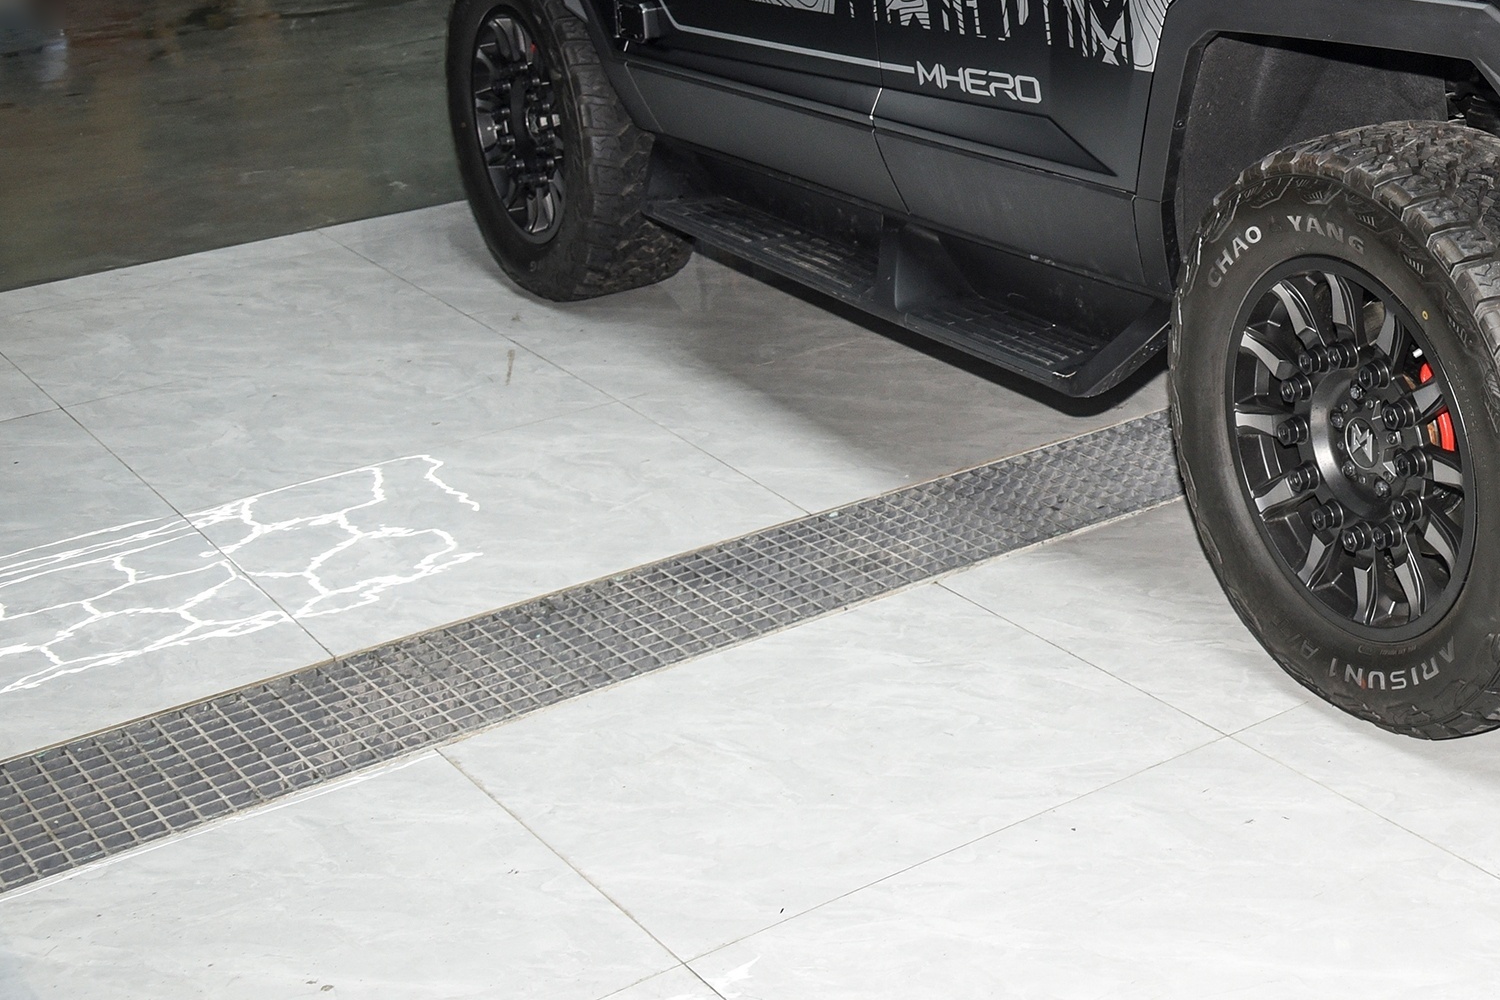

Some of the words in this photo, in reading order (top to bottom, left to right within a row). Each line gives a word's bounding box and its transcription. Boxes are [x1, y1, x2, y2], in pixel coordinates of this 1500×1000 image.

[916, 60, 1042, 104] MHERO
[1207, 225, 1262, 287] CHAO
[1287, 214, 1364, 254] YANG
